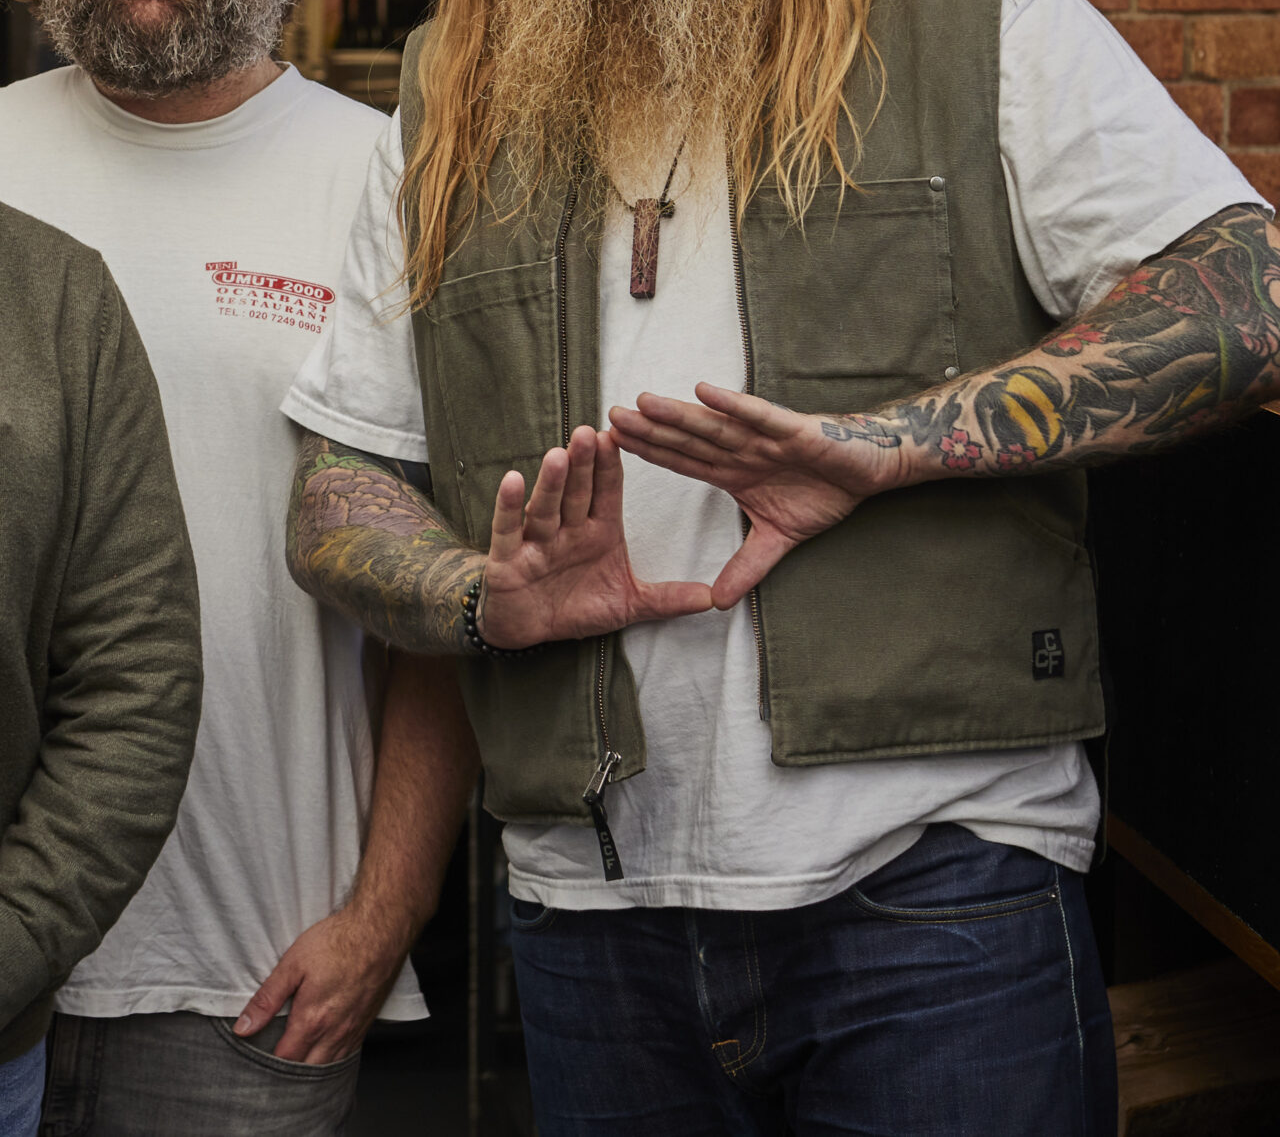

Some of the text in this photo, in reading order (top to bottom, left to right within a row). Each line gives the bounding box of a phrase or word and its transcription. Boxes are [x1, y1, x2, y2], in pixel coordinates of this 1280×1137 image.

[221, 272, 325, 299] UMUT 2000
[215, 295, 328, 323] RESTAURANT
[248, 309, 269, 320] 020
[271, 313, 296, 327] 7249
[298, 320, 322, 334] 0903
